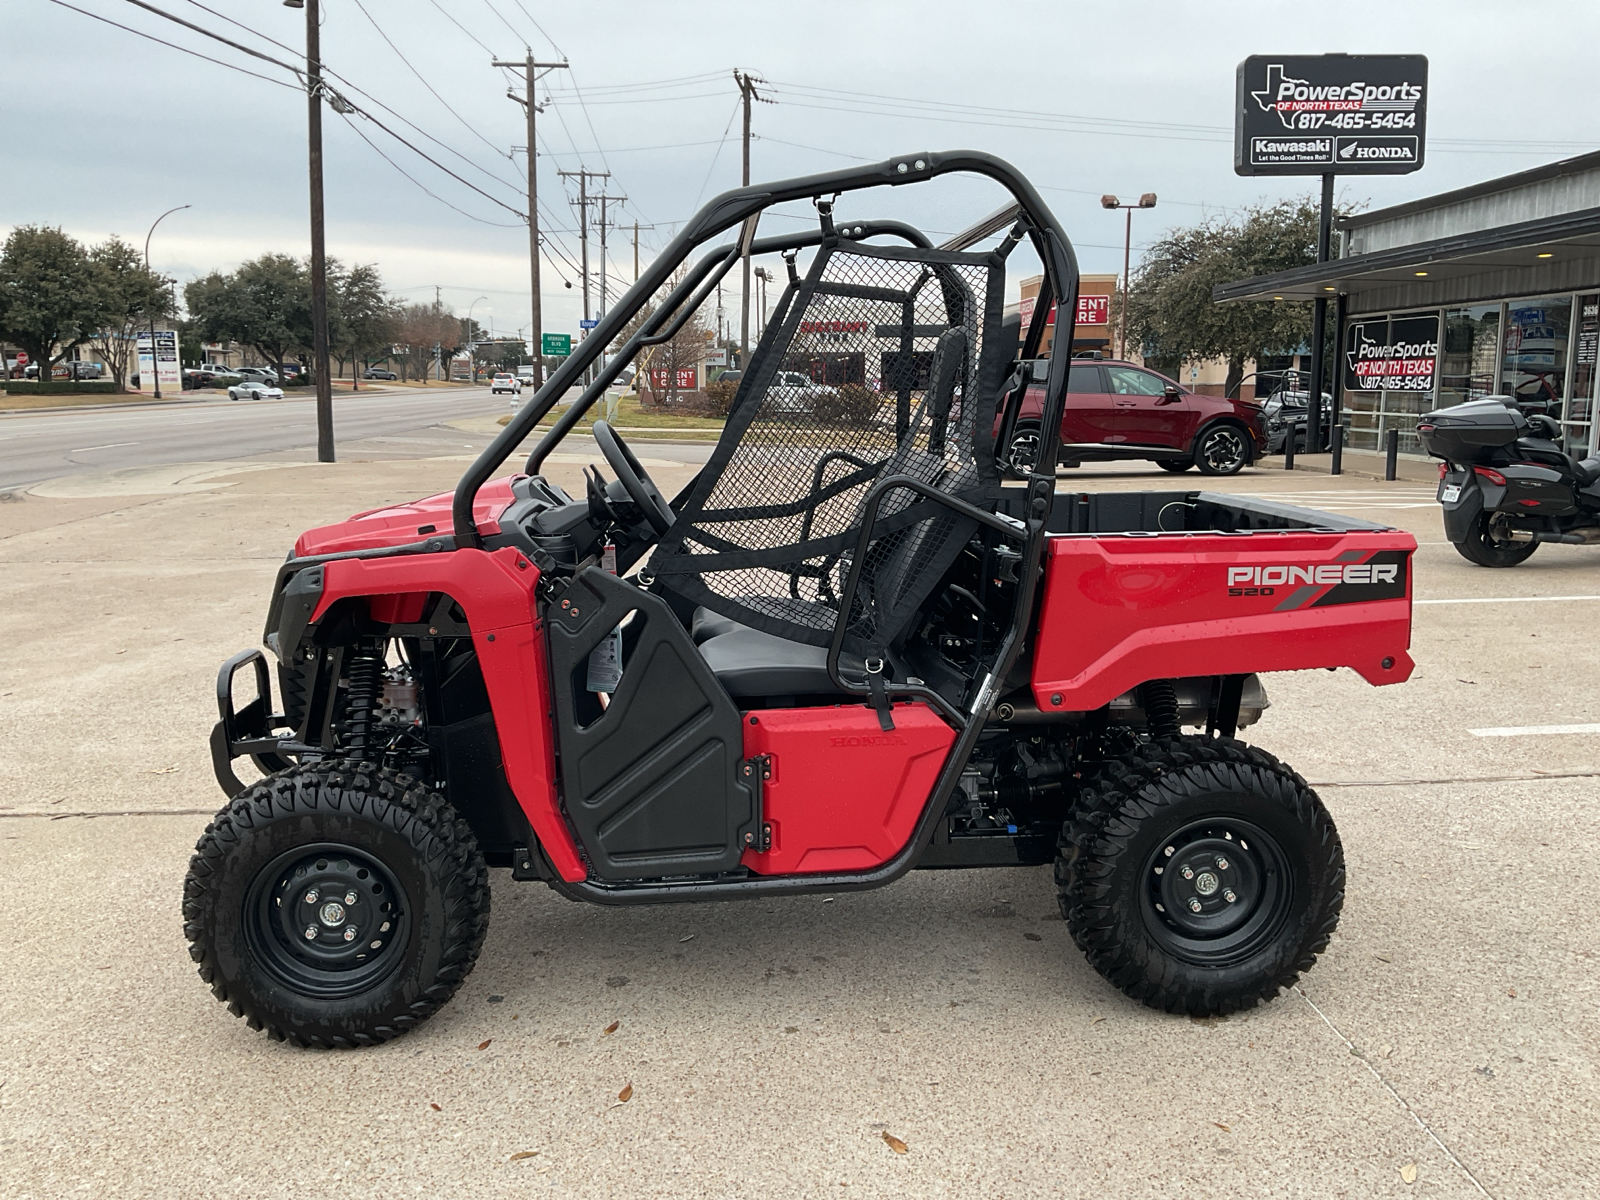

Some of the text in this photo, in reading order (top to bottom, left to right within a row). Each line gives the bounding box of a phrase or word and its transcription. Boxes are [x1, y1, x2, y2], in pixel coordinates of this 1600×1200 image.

[1276, 82, 1422, 103] PowerSports
[1278, 102, 1360, 110] OF NORTH TEXAS
[1298, 112, 1416, 129] 817-465-5454
[1256, 140, 1330, 152] Kawasaki
[1356, 147, 1412, 158] HONDA
[1359, 340, 1438, 359] PowerSports
[1357, 362, 1369, 374] OF
[1402, 360, 1432, 374] TEXAS
[1228, 564, 1397, 586] PIONEER
[1228, 588, 1274, 596] 520
[830, 734, 907, 747] HONDA
